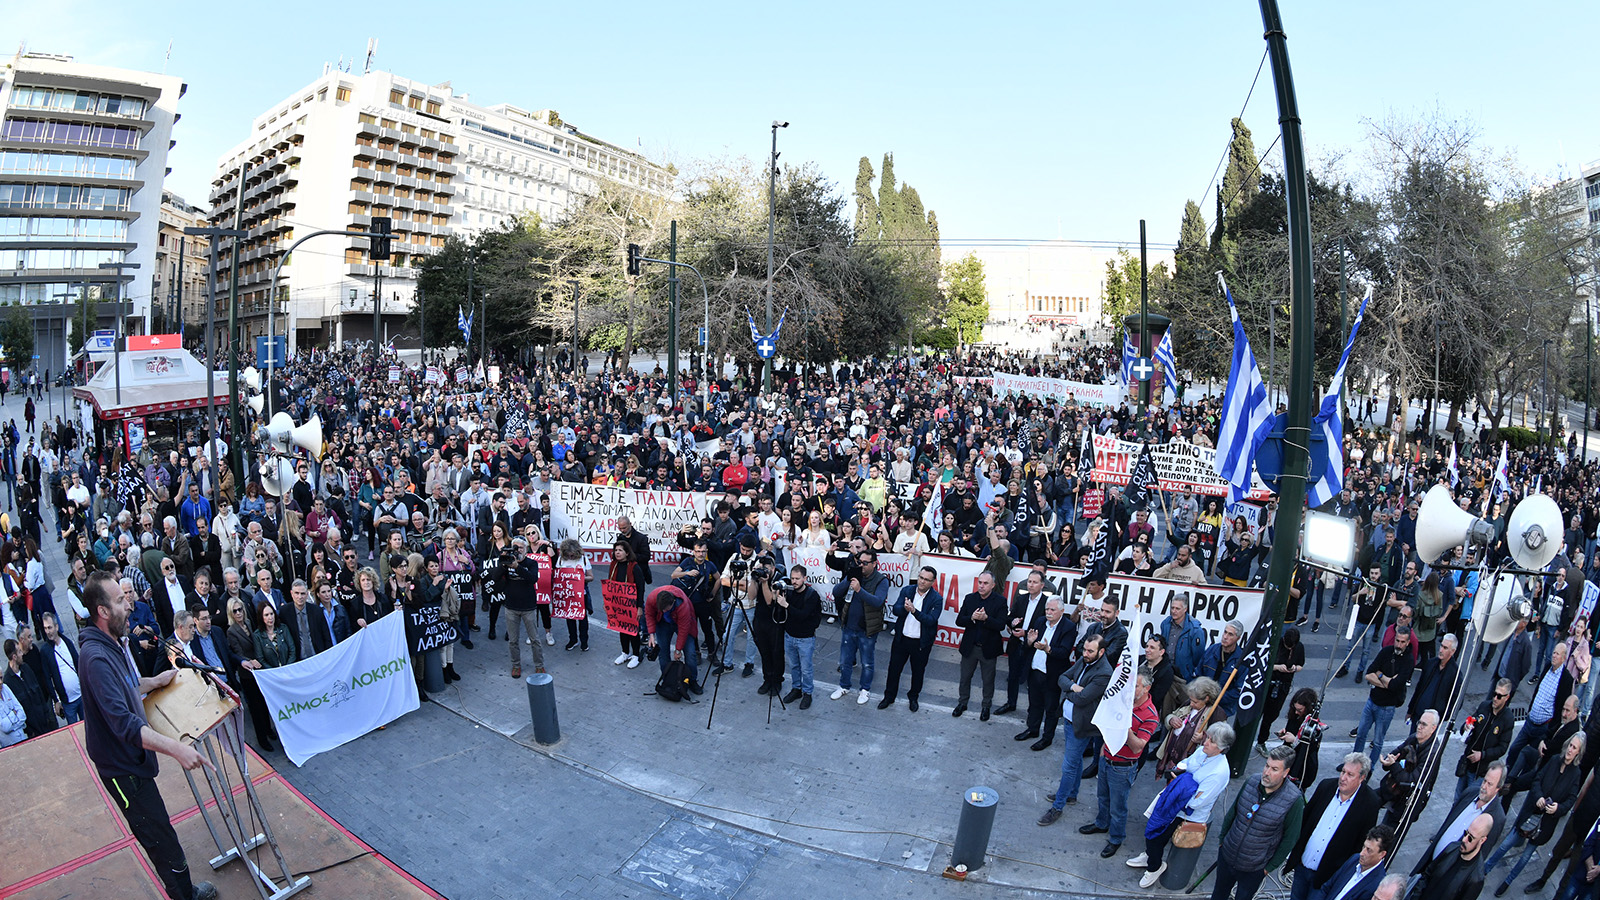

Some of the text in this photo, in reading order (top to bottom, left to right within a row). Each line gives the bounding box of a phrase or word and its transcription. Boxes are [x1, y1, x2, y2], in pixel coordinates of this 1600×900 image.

[1094, 435, 1116, 450] ΟΧΙ
[1118, 443, 1139, 452] ΣΤΟ
[1096, 450, 1129, 473] ΔΕΝ
[560, 484, 695, 510] ΕΙΜΑΣΤΕ ΠΑΙΔΙΑ
[566, 501, 700, 523] ΜΕ ΣΤΟΜΑΤΑ ΑΝΟΙΧΤΑ
[557, 527, 569, 540] ΝΑ
[569, 515, 584, 528] ΤΗ
[589, 518, 621, 532] ΛΑΡΚ
[654, 521, 667, 531] ΘΑ
[482, 557, 500, 570] ΚΑΤ
[606, 582, 637, 596] ΕΡΓΑΤΕΣ
[1138, 586, 1155, 614] Η
[417, 626, 457, 652] ΛΑΡΚΟ
[352, 656, 407, 690] ΛΟΚΡΩΝ
[278, 692, 330, 722] ΔΗΜΟΣ
